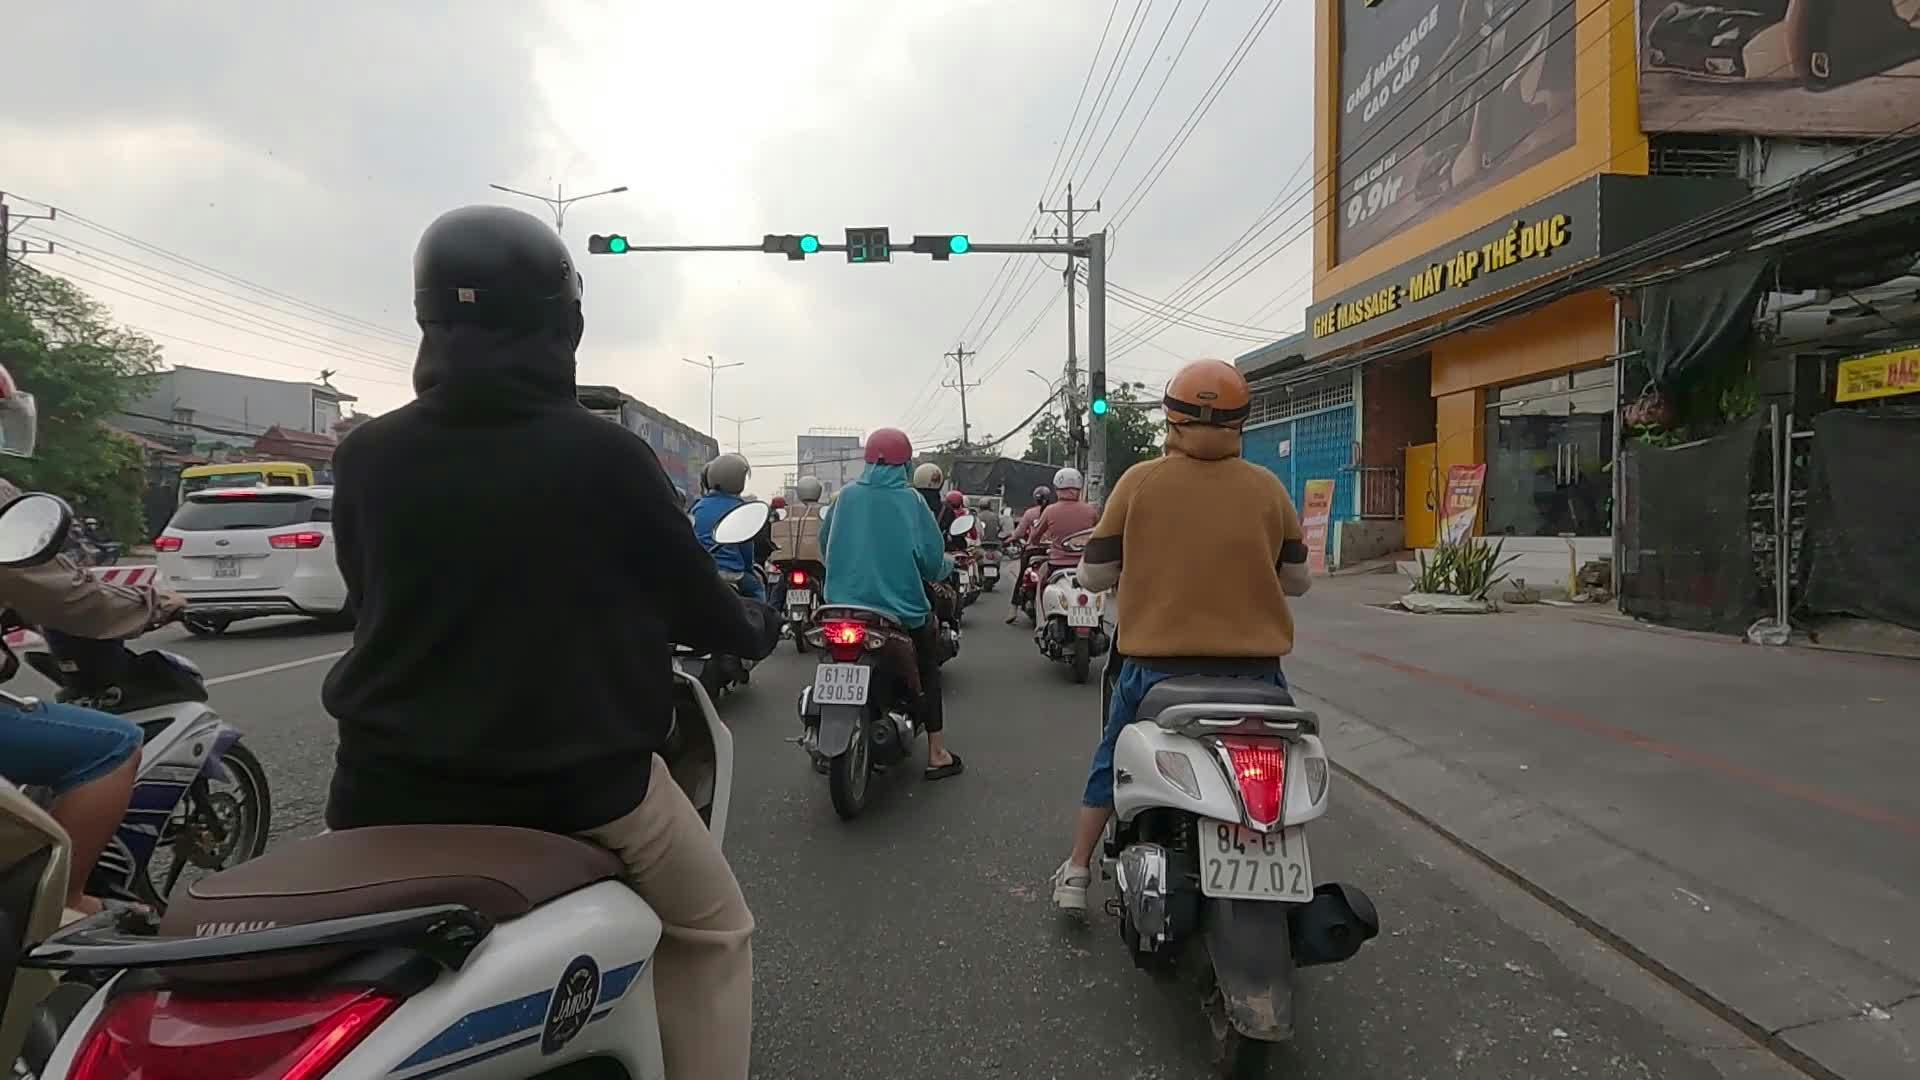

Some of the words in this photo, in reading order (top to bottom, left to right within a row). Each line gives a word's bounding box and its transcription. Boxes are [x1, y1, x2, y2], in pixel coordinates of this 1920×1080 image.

[1373, 4, 1439, 88] MASSAGE
[1364, 86, 1390, 122] CAO
[1313, 306, 1336, 339] GHẾ
[1337, 285, 1397, 331] MASSAGE
[1409, 263, 1443, 302] MÁY
[1446, 250, 1479, 288] TẬP
[1482, 219, 1518, 273] THỂ
[1520, 213, 1565, 258] DỤC
[817, 684, 864, 701] 290.58
[825, 667, 861, 684] 61-H1
[1217, 823, 1288, 858] 84-G1
[1209, 858, 1305, 895] 277.02
[552, 988, 593, 1023] JANUS
